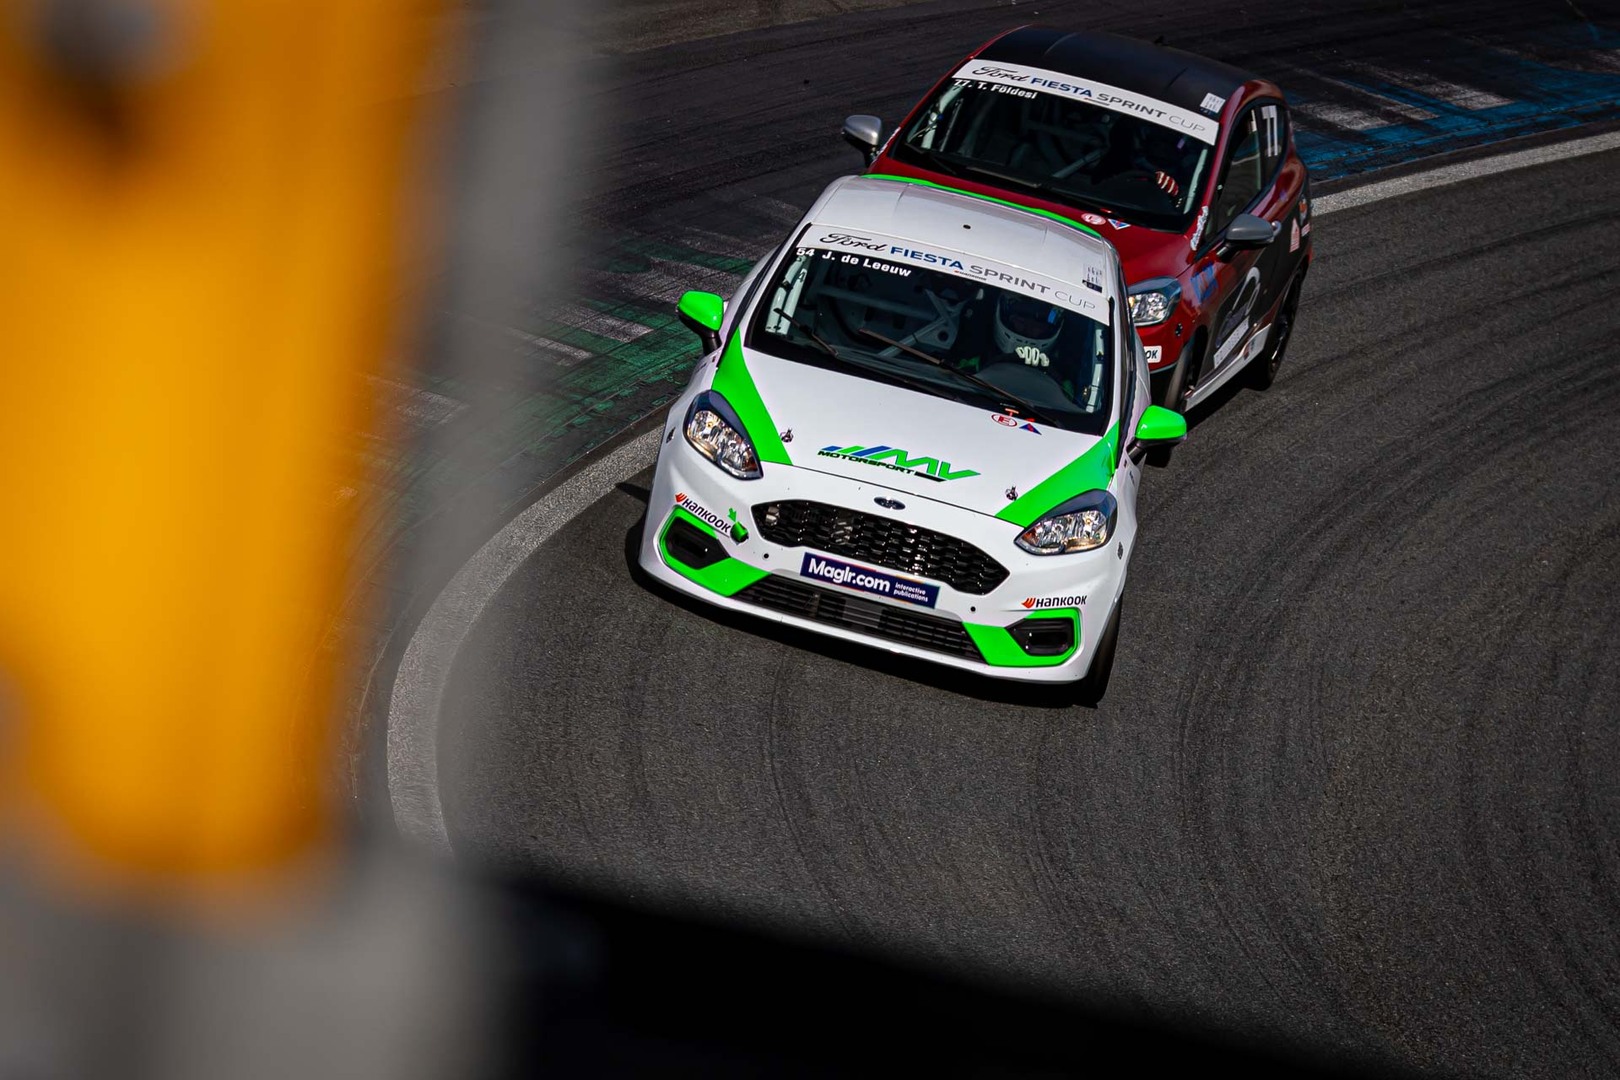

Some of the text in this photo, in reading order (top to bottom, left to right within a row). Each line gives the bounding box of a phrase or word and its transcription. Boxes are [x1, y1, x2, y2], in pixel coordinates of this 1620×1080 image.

[977, 81, 988, 91] T.
[972, 66, 1031, 82] Ford
[1030, 77, 1093, 98] FIESTA
[1096, 93, 1167, 119] SPRINT
[1168, 115, 1206, 133] CUP
[796, 247, 912, 277] 54 J. de Leeuw
[819, 233, 888, 252] Ford
[889, 246, 964, 271] FIESTA
[968, 264, 1051, 294] SPRINT
[1054, 290, 1096, 310] CUP
[817, 450, 915, 475] MOTORSPORT
[893, 589, 929, 602] publications
[894, 582, 926, 595] interactive
